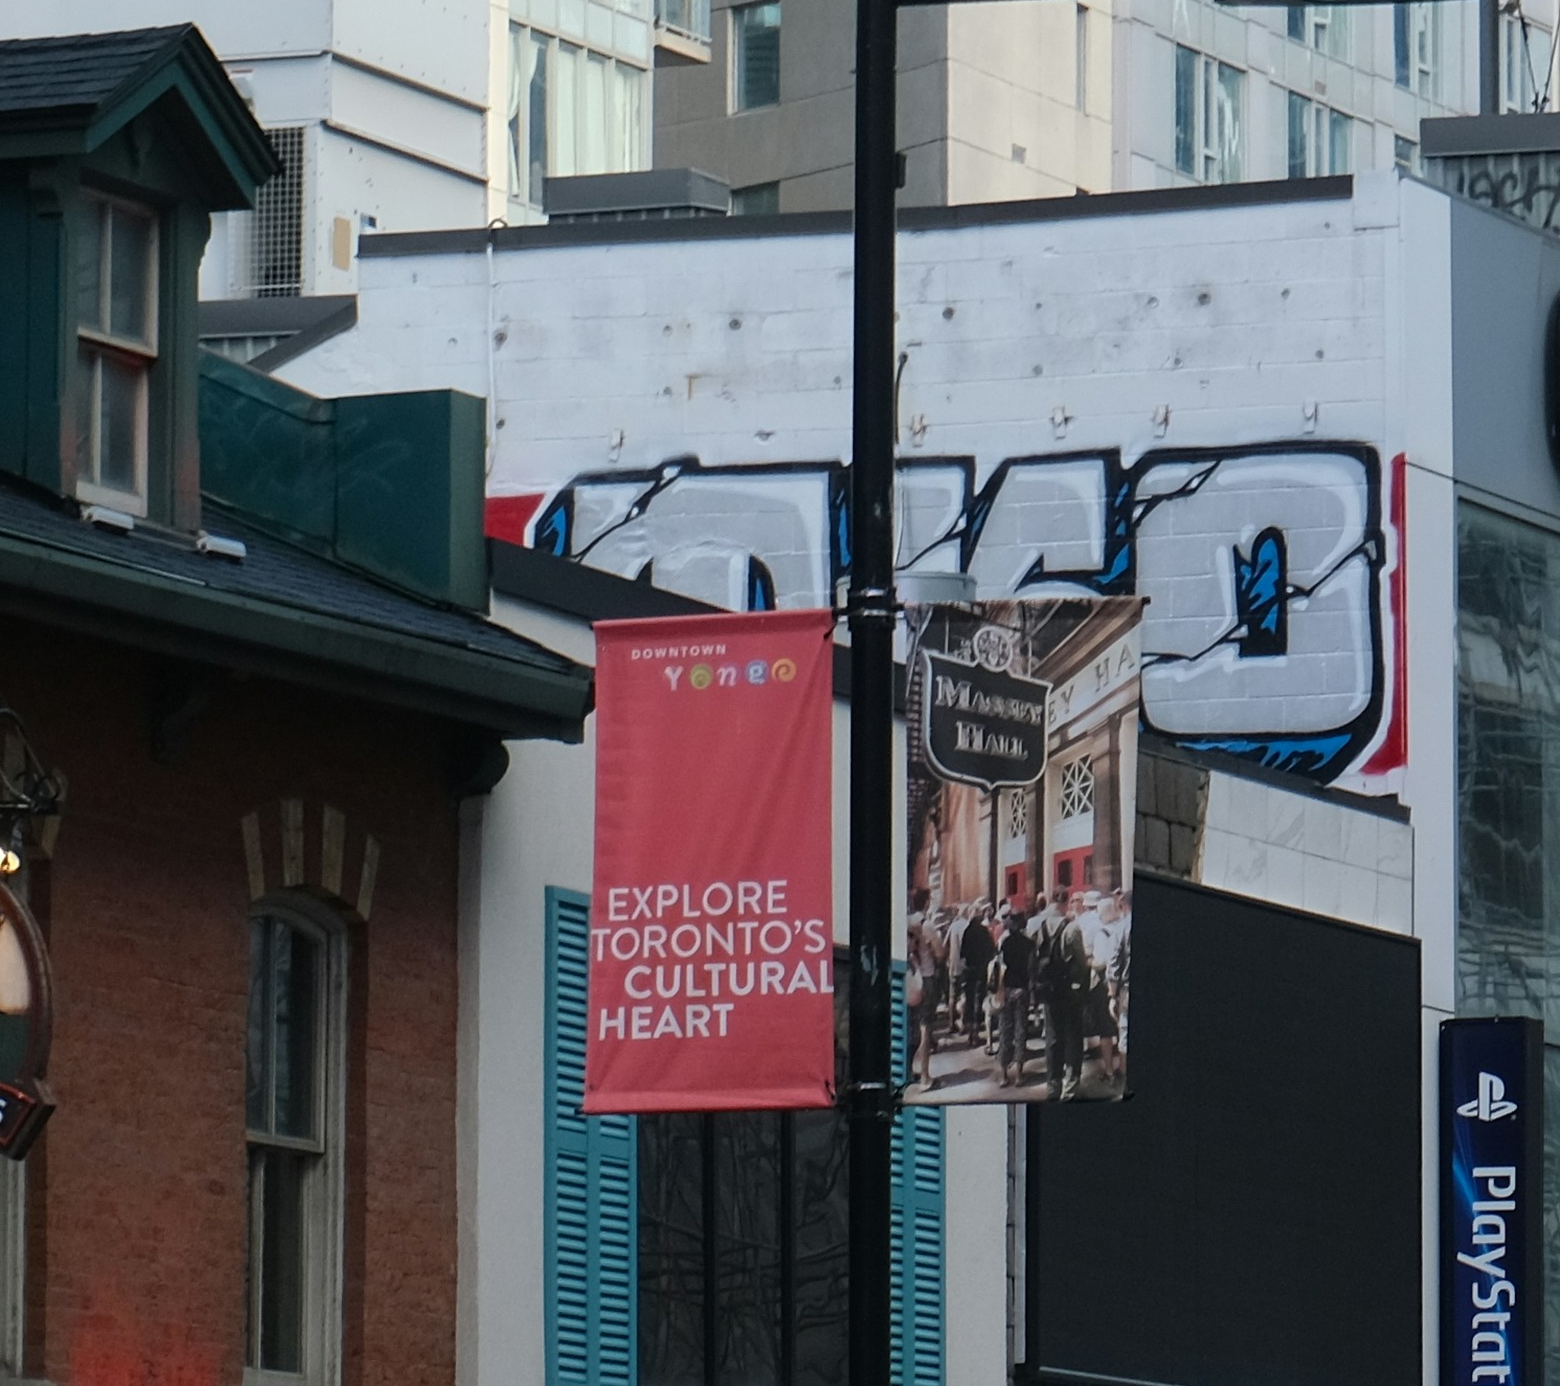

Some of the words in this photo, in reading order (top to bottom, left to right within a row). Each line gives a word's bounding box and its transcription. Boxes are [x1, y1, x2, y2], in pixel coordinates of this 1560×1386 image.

[631, 643, 726, 660] DOWNTOWN
[608, 879, 788, 921] EXPLORE
[591, 919, 825, 962] TORONTO'S
[624, 960, 833, 999] CULTURAL
[599, 1002, 734, 1040] HEART
